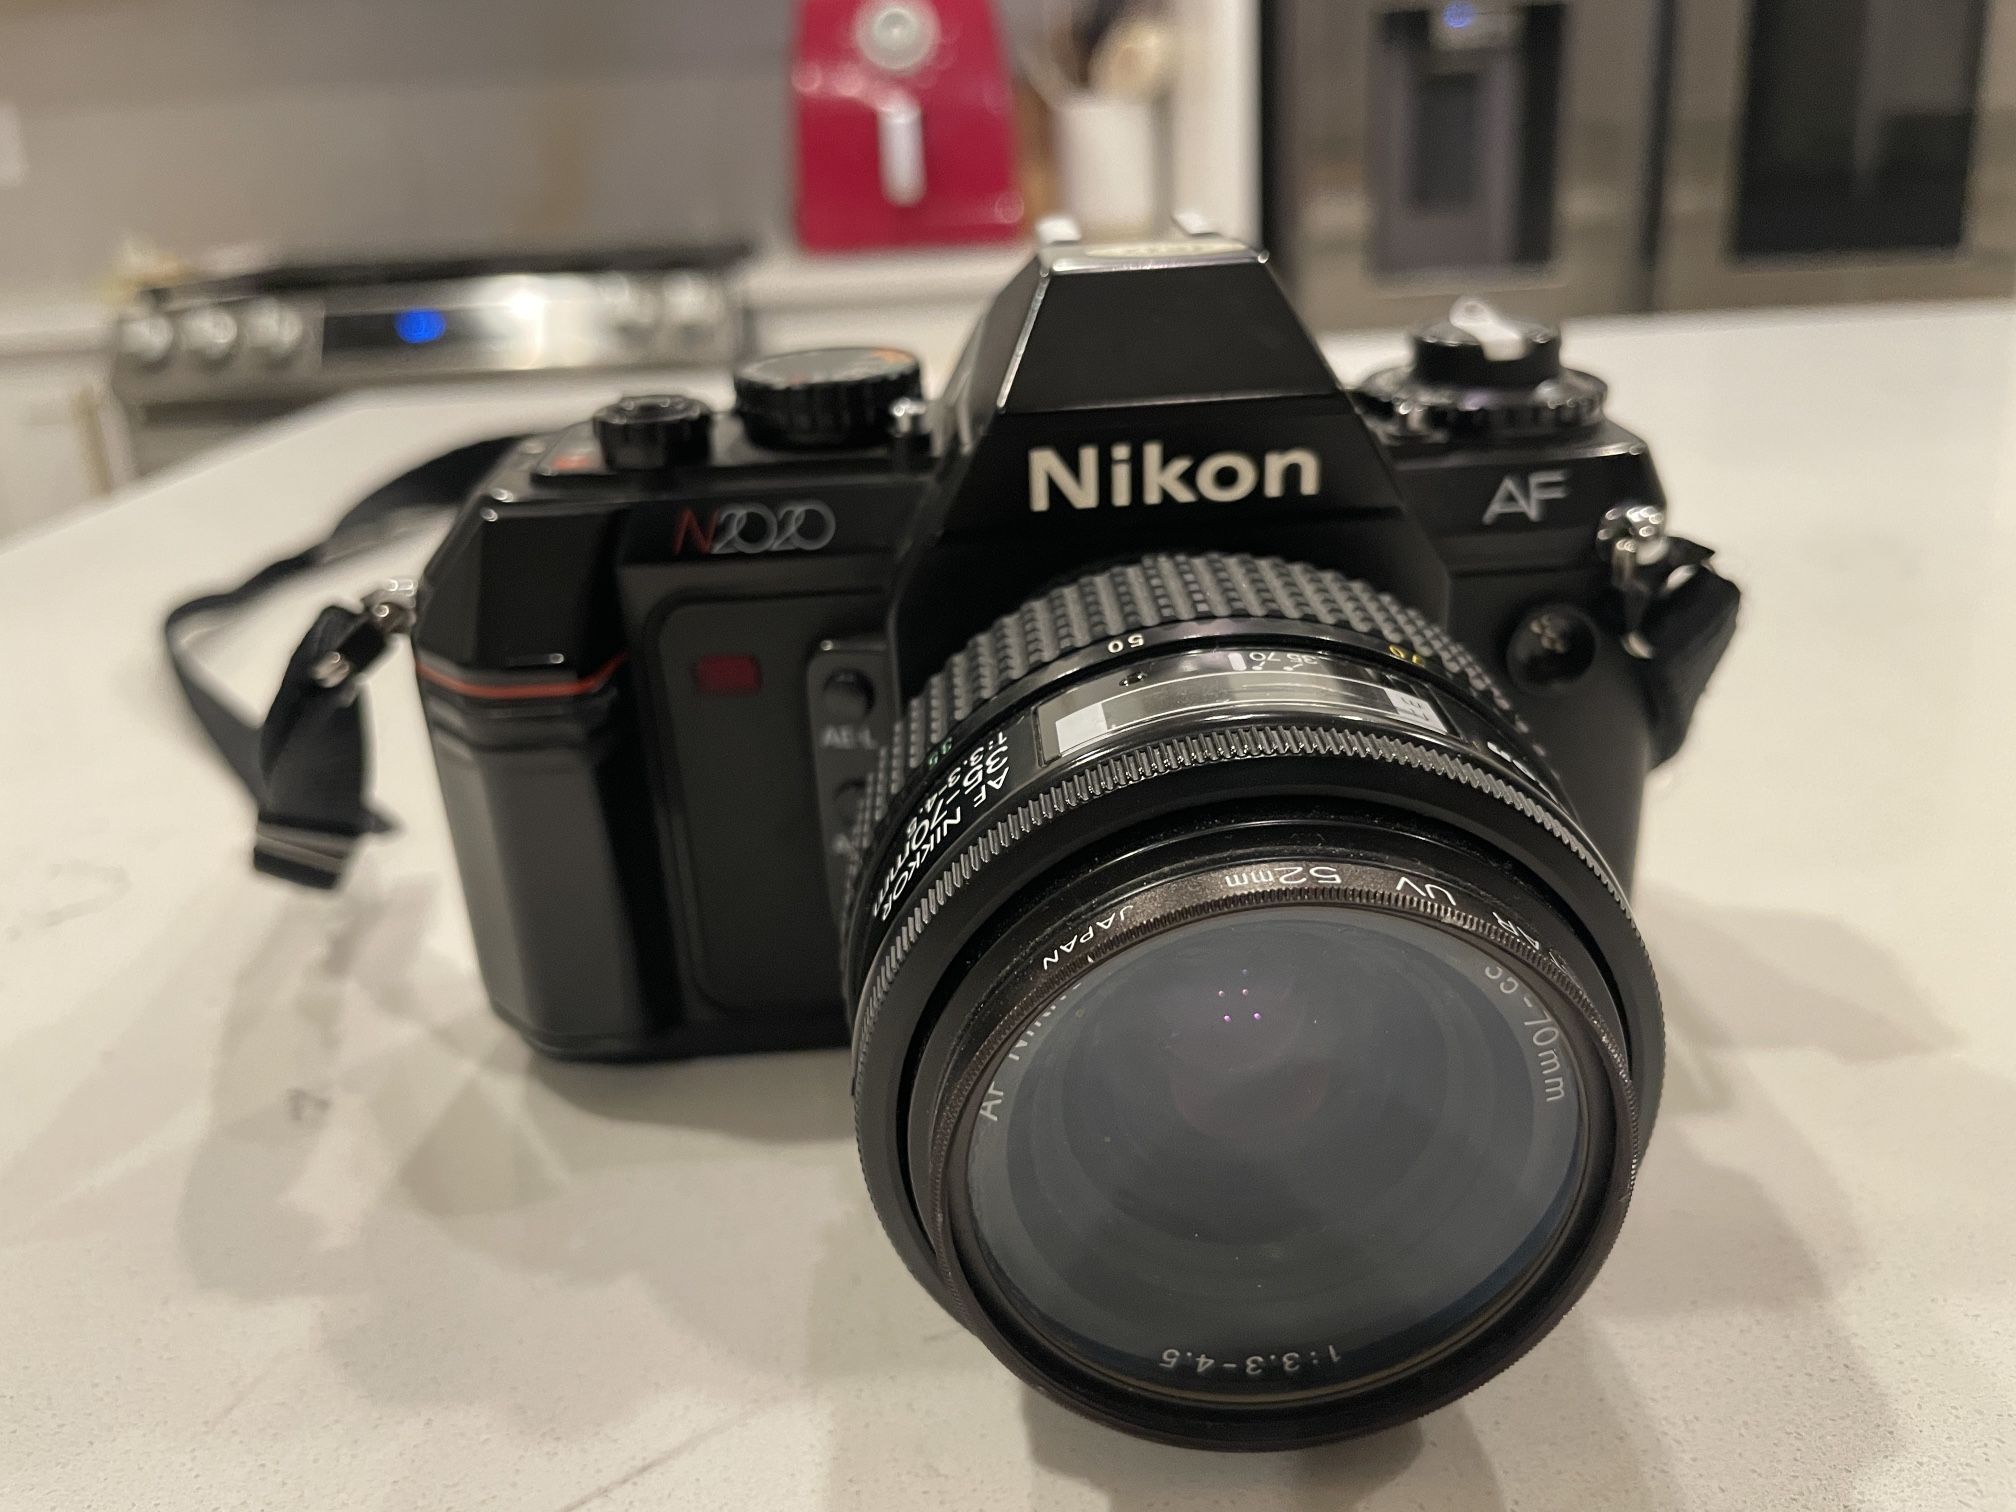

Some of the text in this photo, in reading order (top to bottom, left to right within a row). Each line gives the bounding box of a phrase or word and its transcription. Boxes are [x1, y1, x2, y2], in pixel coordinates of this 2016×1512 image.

[1028, 441, 1321, 512] Nikon
[1482, 468, 1571, 526] AF
[672, 501, 837, 555] N2020
[1107, 633, 1145, 653] 50
[1249, 651, 1281, 662] 70
[872, 746, 1009, 917] 35-70mm
[880, 767, 1010, 922] AF NIKKOR
[1224, 866, 1343, 888] 52mm
[1395, 876, 1457, 906] UV
[1042, 904, 1134, 970] JAPAN
[1158, 1344, 1342, 1375] 1:3.3-4.5
